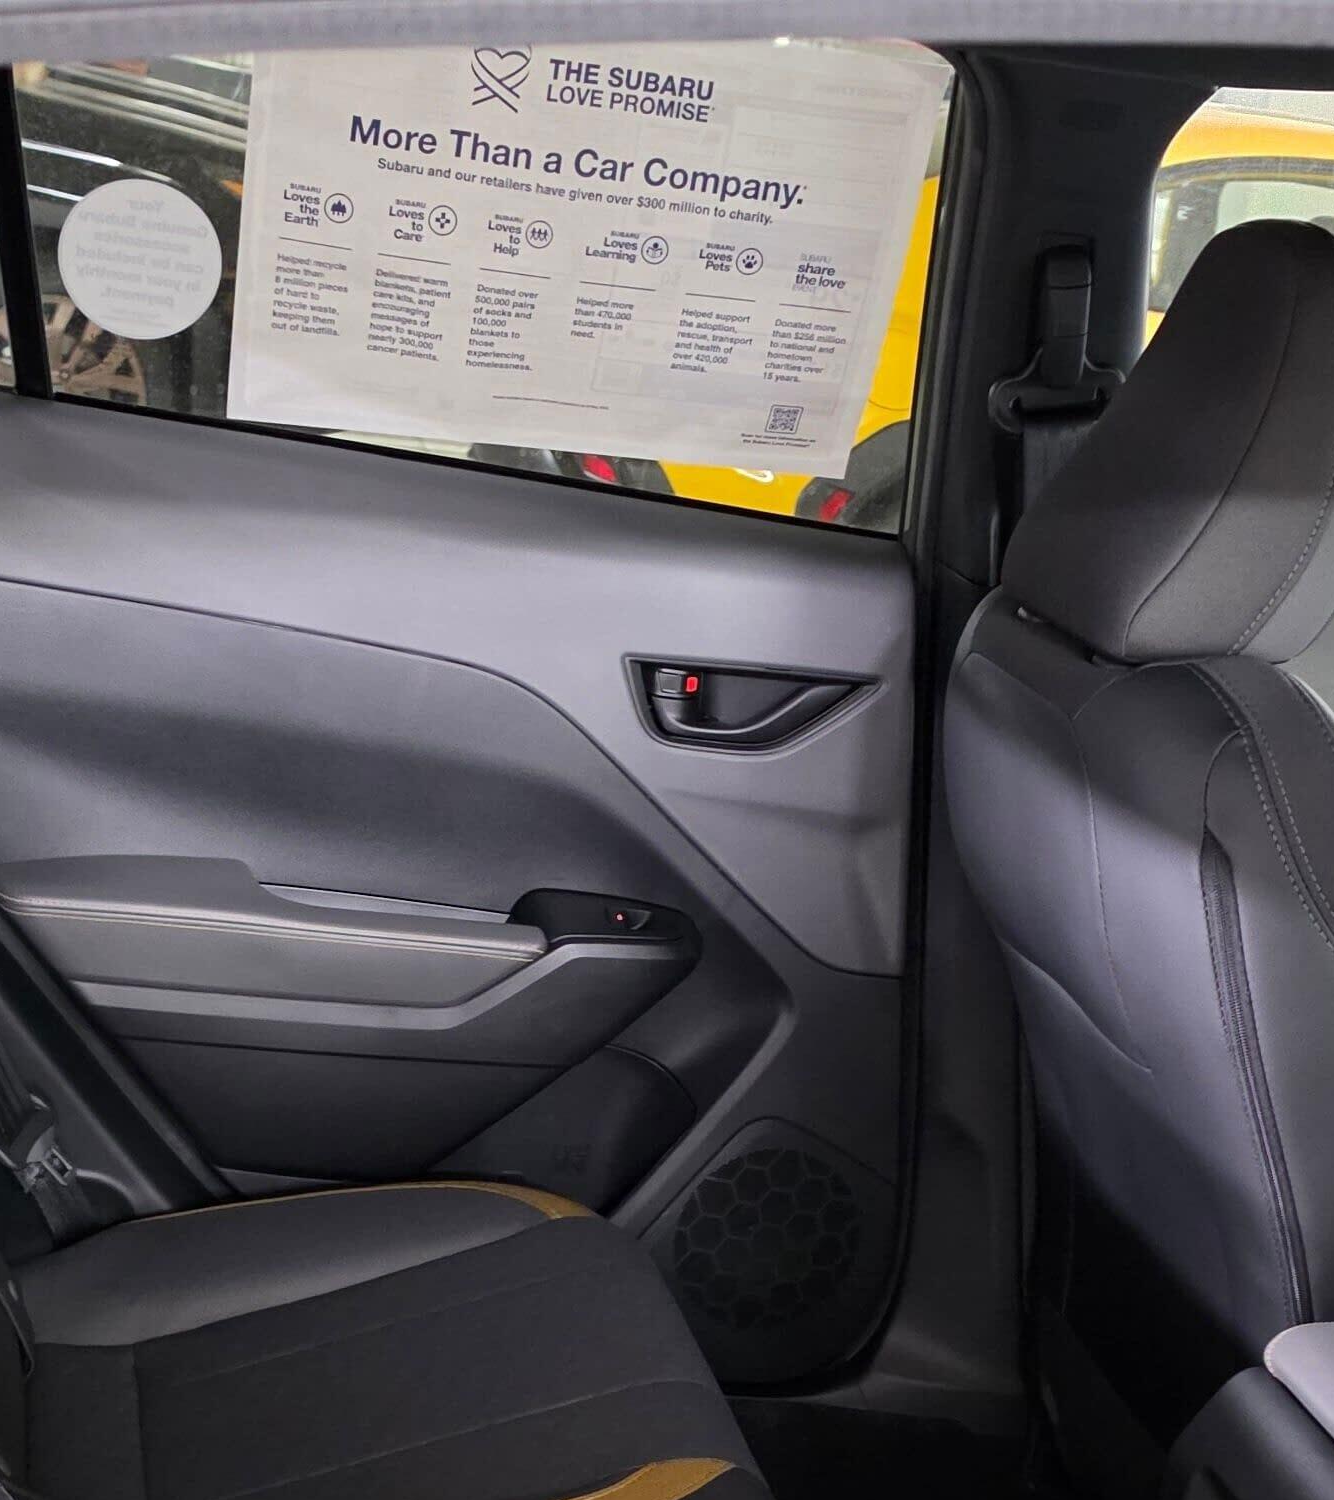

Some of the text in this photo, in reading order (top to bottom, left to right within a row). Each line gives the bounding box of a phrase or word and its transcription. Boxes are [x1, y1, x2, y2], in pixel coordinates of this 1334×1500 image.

[550, 59, 714, 100] THE SUBARU
[547, 85, 710, 122] LOVE PROMISE
[350, 115, 804, 209] More Than a Car Company.
[290, 183, 321, 194] SUBARU
[378, 158, 773, 225] Subaru and our retailers have given over $300 million to charity.
[284, 189, 320, 205] Loves
[396, 199, 426, 208] SUBARU
[300, 204, 319, 215] the
[389, 206, 424, 220] Loves
[285, 212, 318, 227] Earth
[495, 214, 523, 223] SUBARU
[412, 221, 423, 231] to
[488, 220, 521, 234] Loves
[394, 229, 422, 242] Care
[509, 234, 520, 244] to
[611, 231, 640, 239] SUBARU
[493, 243, 519, 257] Help
[604, 237, 637, 250] Loves
[706, 242, 735, 251] SUBARU
[586, 246, 636, 263] Learning
[699, 249, 733, 262] Loves
[705, 261, 731, 272] Pets
[798, 263, 835, 276] share
[795, 274, 845, 289] the love
